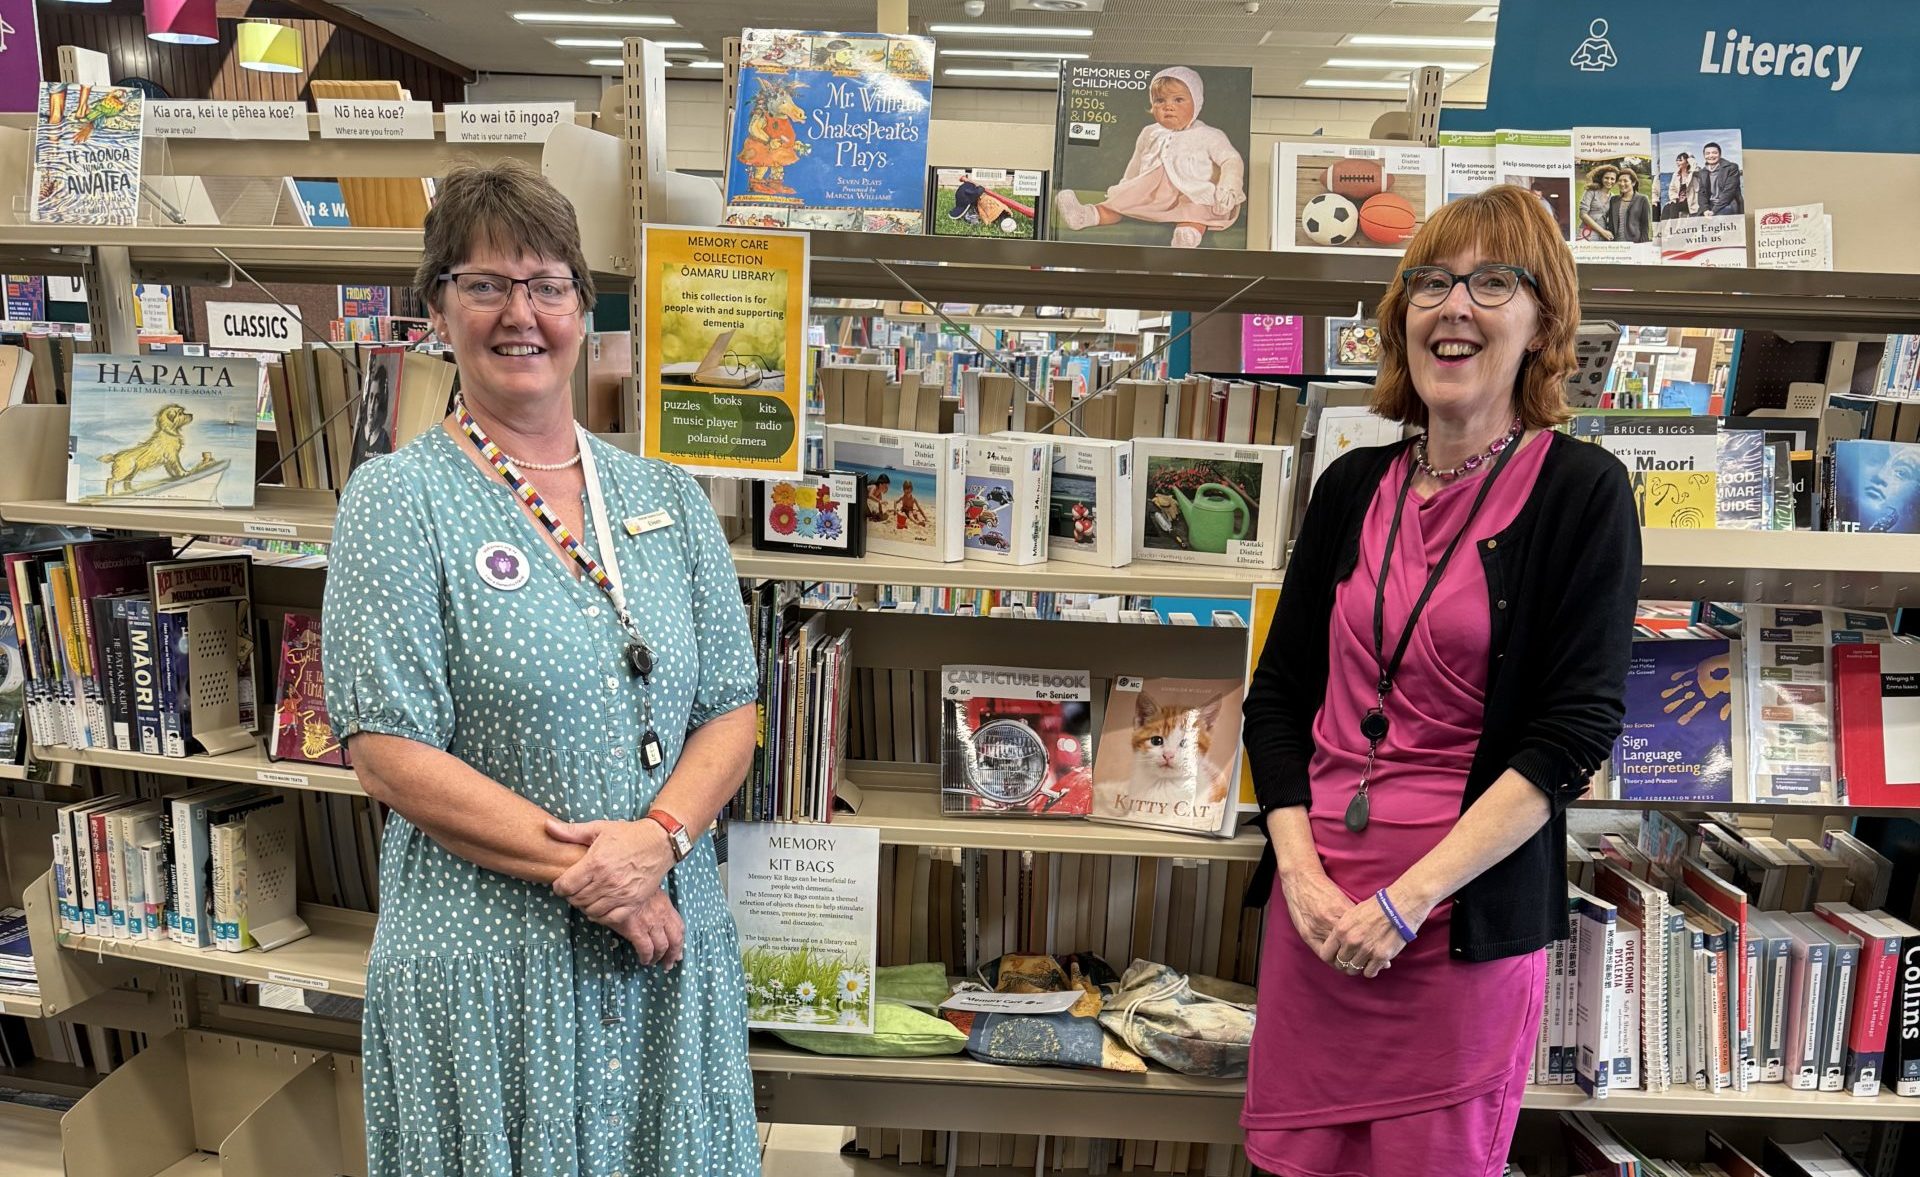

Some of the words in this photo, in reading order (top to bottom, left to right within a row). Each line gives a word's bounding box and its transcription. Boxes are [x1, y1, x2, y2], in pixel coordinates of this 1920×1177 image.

[1700, 29, 1862, 91] Literacy
[1072, 67, 1131, 79] MEMORIES
[1134, 70, 1150, 80] OF
[1072, 78, 1147, 90] CHILDHOOD
[825, 82, 855, 109] Mr.
[1070, 97, 1105, 110] 1950s
[153, 105, 170, 118] Kia
[174, 107, 196, 120] ora,
[199, 106, 215, 118] kei
[218, 108, 230, 118] te
[232, 106, 266, 120] pēhea
[269, 106, 294, 119] koe?
[334, 105, 350, 119] Nō
[354, 106, 374, 119] hea
[378, 106, 404, 120] koe?
[461, 111, 476, 124] Ko
[480, 111, 500, 123] wai
[504, 110, 516, 124] tō
[520, 110, 560, 126] ingoa?
[155, 126, 168, 134] How
[182, 127, 196, 136] you?
[336, 127, 357, 136] Where
[370, 128, 383, 137] you
[384, 128, 404, 136] from?
[808, 108, 919, 143] Shakespeare's
[462, 132, 479, 140] What
[482, 132, 487, 140] is
[488, 134, 502, 142] your
[504, 132, 526, 141] name?
[67, 151, 79, 164] TE
[84, 148, 130, 162] TAONGA
[835, 142, 887, 172] Plays
[67, 170, 130, 196] AWATEA
[319, 207, 329, 218] &
[1670, 225, 1697, 236] Learn
[1701, 222, 1737, 233] English
[688, 236, 737, 248] MEMORY
[740, 239, 769, 250] CARE
[1686, 236, 1708, 244] with
[1758, 237, 1806, 248] telephone
[693, 252, 763, 266] COLLECTION
[1758, 248, 1817, 260] interpreting
[732, 270, 776, 282] LIBRARY
[682, 291, 698, 300] this
[700, 292, 743, 303] collection
[745, 294, 752, 304] is
[754, 294, 768, 304] for
[664, 304, 694, 314] people
[696, 305, 716, 314] with
[718, 307, 734, 316] and
[736, 308, 784, 320] supporting
[224, 314, 289, 340] CLASSICS
[703, 318, 745, 329] dementia
[97, 360, 235, 388] HĀPATA
[664, 400, 701, 412] puzzles
[714, 394, 742, 406] books
[759, 403, 777, 414] kits
[673, 416, 704, 426] music
[706, 417, 738, 430] player
[756, 420, 782, 431] radio
[1614, 426, 1652, 434] BRUCE
[1658, 426, 1696, 434] BIGGS
[688, 434, 728, 444] polaroid
[730, 436, 767, 446] camera
[914, 442, 935, 450] Waitaki
[914, 450, 934, 459] District
[912, 459, 936, 467] Libraries
[1636, 456, 1694, 471] Maori
[1239, 540, 1264, 548] Waitaki
[1236, 556, 1264, 565] Libraries
[114, 638, 120, 648] HE
[114, 652, 125, 687] PĀTAKA
[131, 630, 154, 711] MĀORI
[948, 670, 978, 684] CAR
[982, 671, 1040, 687] PICTURE
[1042, 674, 1087, 690] BOOK
[119, 690, 128, 714] KUPU
[1036, 691, 1048, 700] for
[1050, 692, 1079, 700] Seniors
[1622, 736, 1648, 750] Sign
[1623, 749, 1682, 762] Language
[1623, 762, 1701, 776] Interpreting
[1114, 794, 1168, 815] KITTY
[1174, 800, 1210, 818] CAT
[180, 810, 188, 849] BECOMING
[769, 837, 836, 851] MEMORY
[770, 858, 792, 870] KIT
[796, 860, 834, 873] BAGS
[182, 862, 190, 899] MICHELLE
[1614, 948, 1624, 988] DYSLEXIA
[1624, 940, 1635, 994] OVERCOMING
[1876, 970, 1885, 994] Zealand
[1902, 946, 1920, 1040] Collins
[1874, 995, 1882, 1008] Sign
[1869, 1010, 1878, 1038] Language
